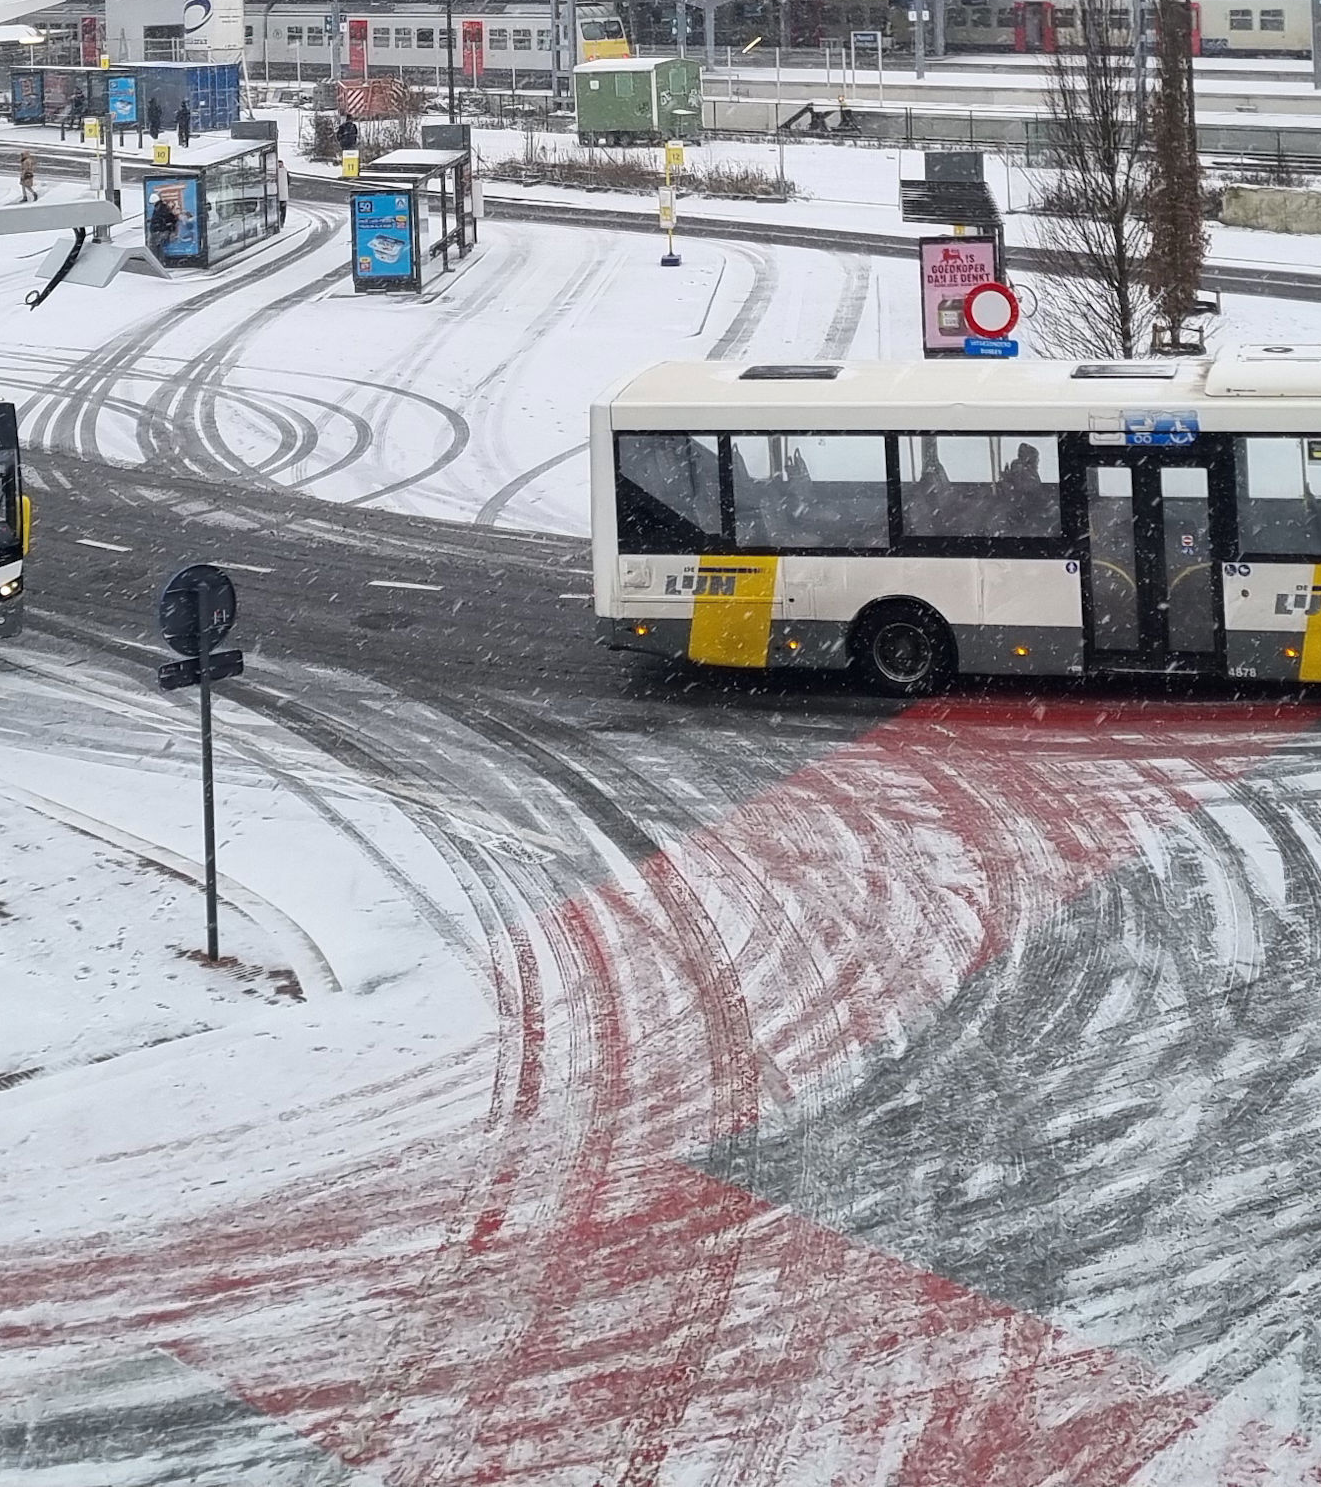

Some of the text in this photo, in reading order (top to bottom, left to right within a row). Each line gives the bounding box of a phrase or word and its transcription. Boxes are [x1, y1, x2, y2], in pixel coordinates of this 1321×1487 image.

[965, 254, 975, 263] IS
[931, 264, 985, 274] GOEDKOPER
[927, 273, 990, 284] DAN JE DENKT
[1228, 667, 1257, 678] 4878
